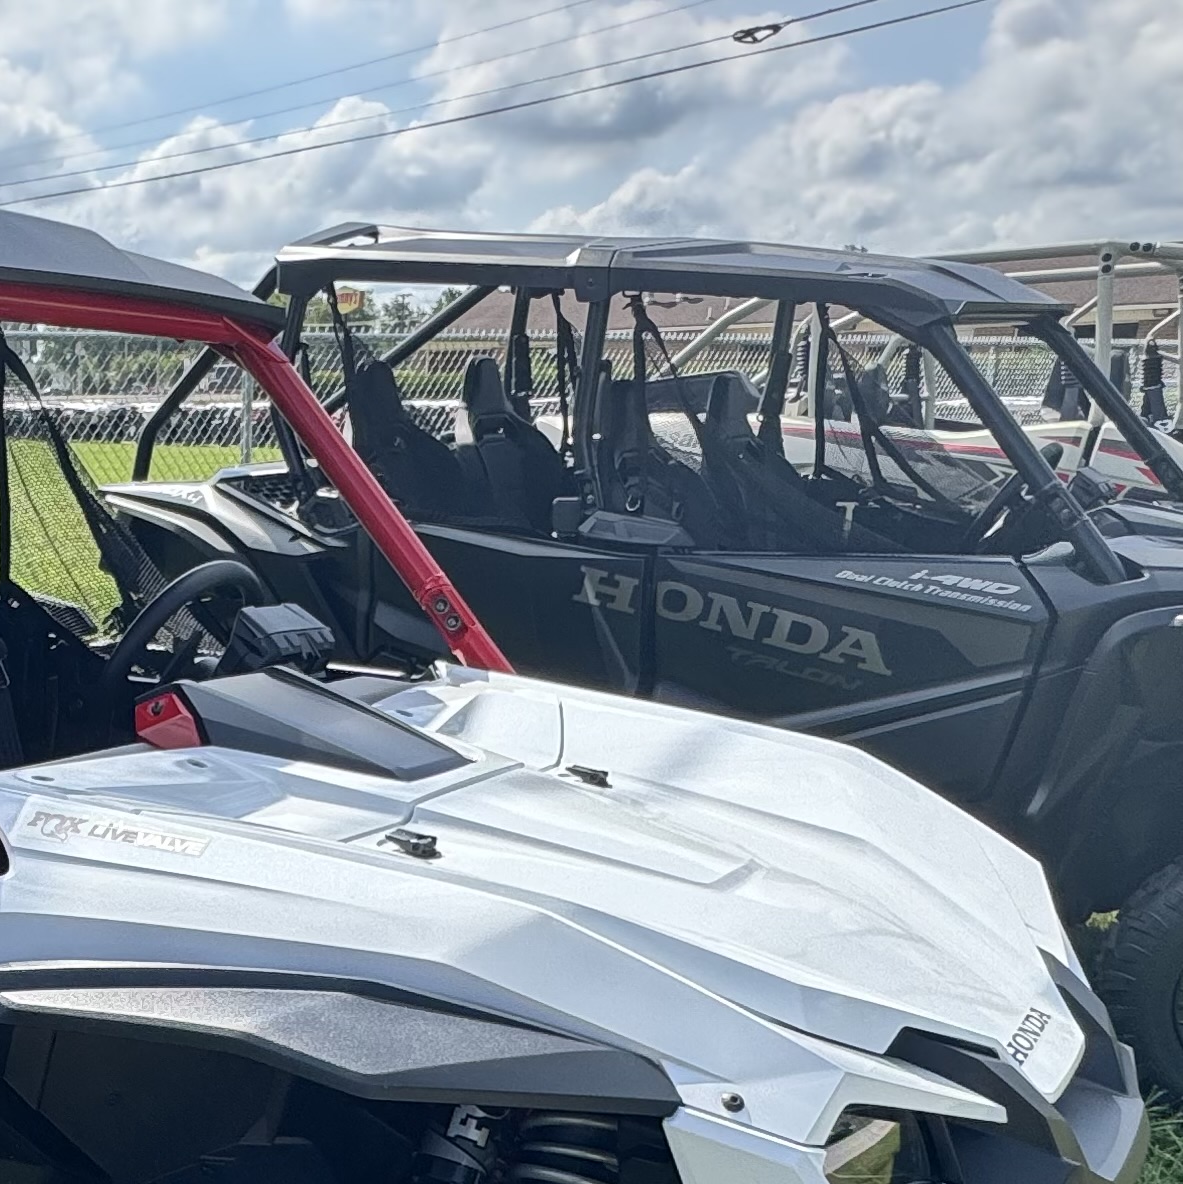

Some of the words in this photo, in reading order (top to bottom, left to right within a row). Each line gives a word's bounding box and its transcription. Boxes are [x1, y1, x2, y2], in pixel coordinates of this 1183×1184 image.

[835, 570, 875, 583] Dual
[873, 576, 924, 592] Clutch
[923, 585, 1032, 612] Transmission
[909, 569, 1021, 595] i-4WD
[573, 565, 892, 676] HONDA
[725, 646, 865, 690] TALON
[27, 811, 89, 843] FOX
[1006, 1006, 1052, 1067] HONDA
